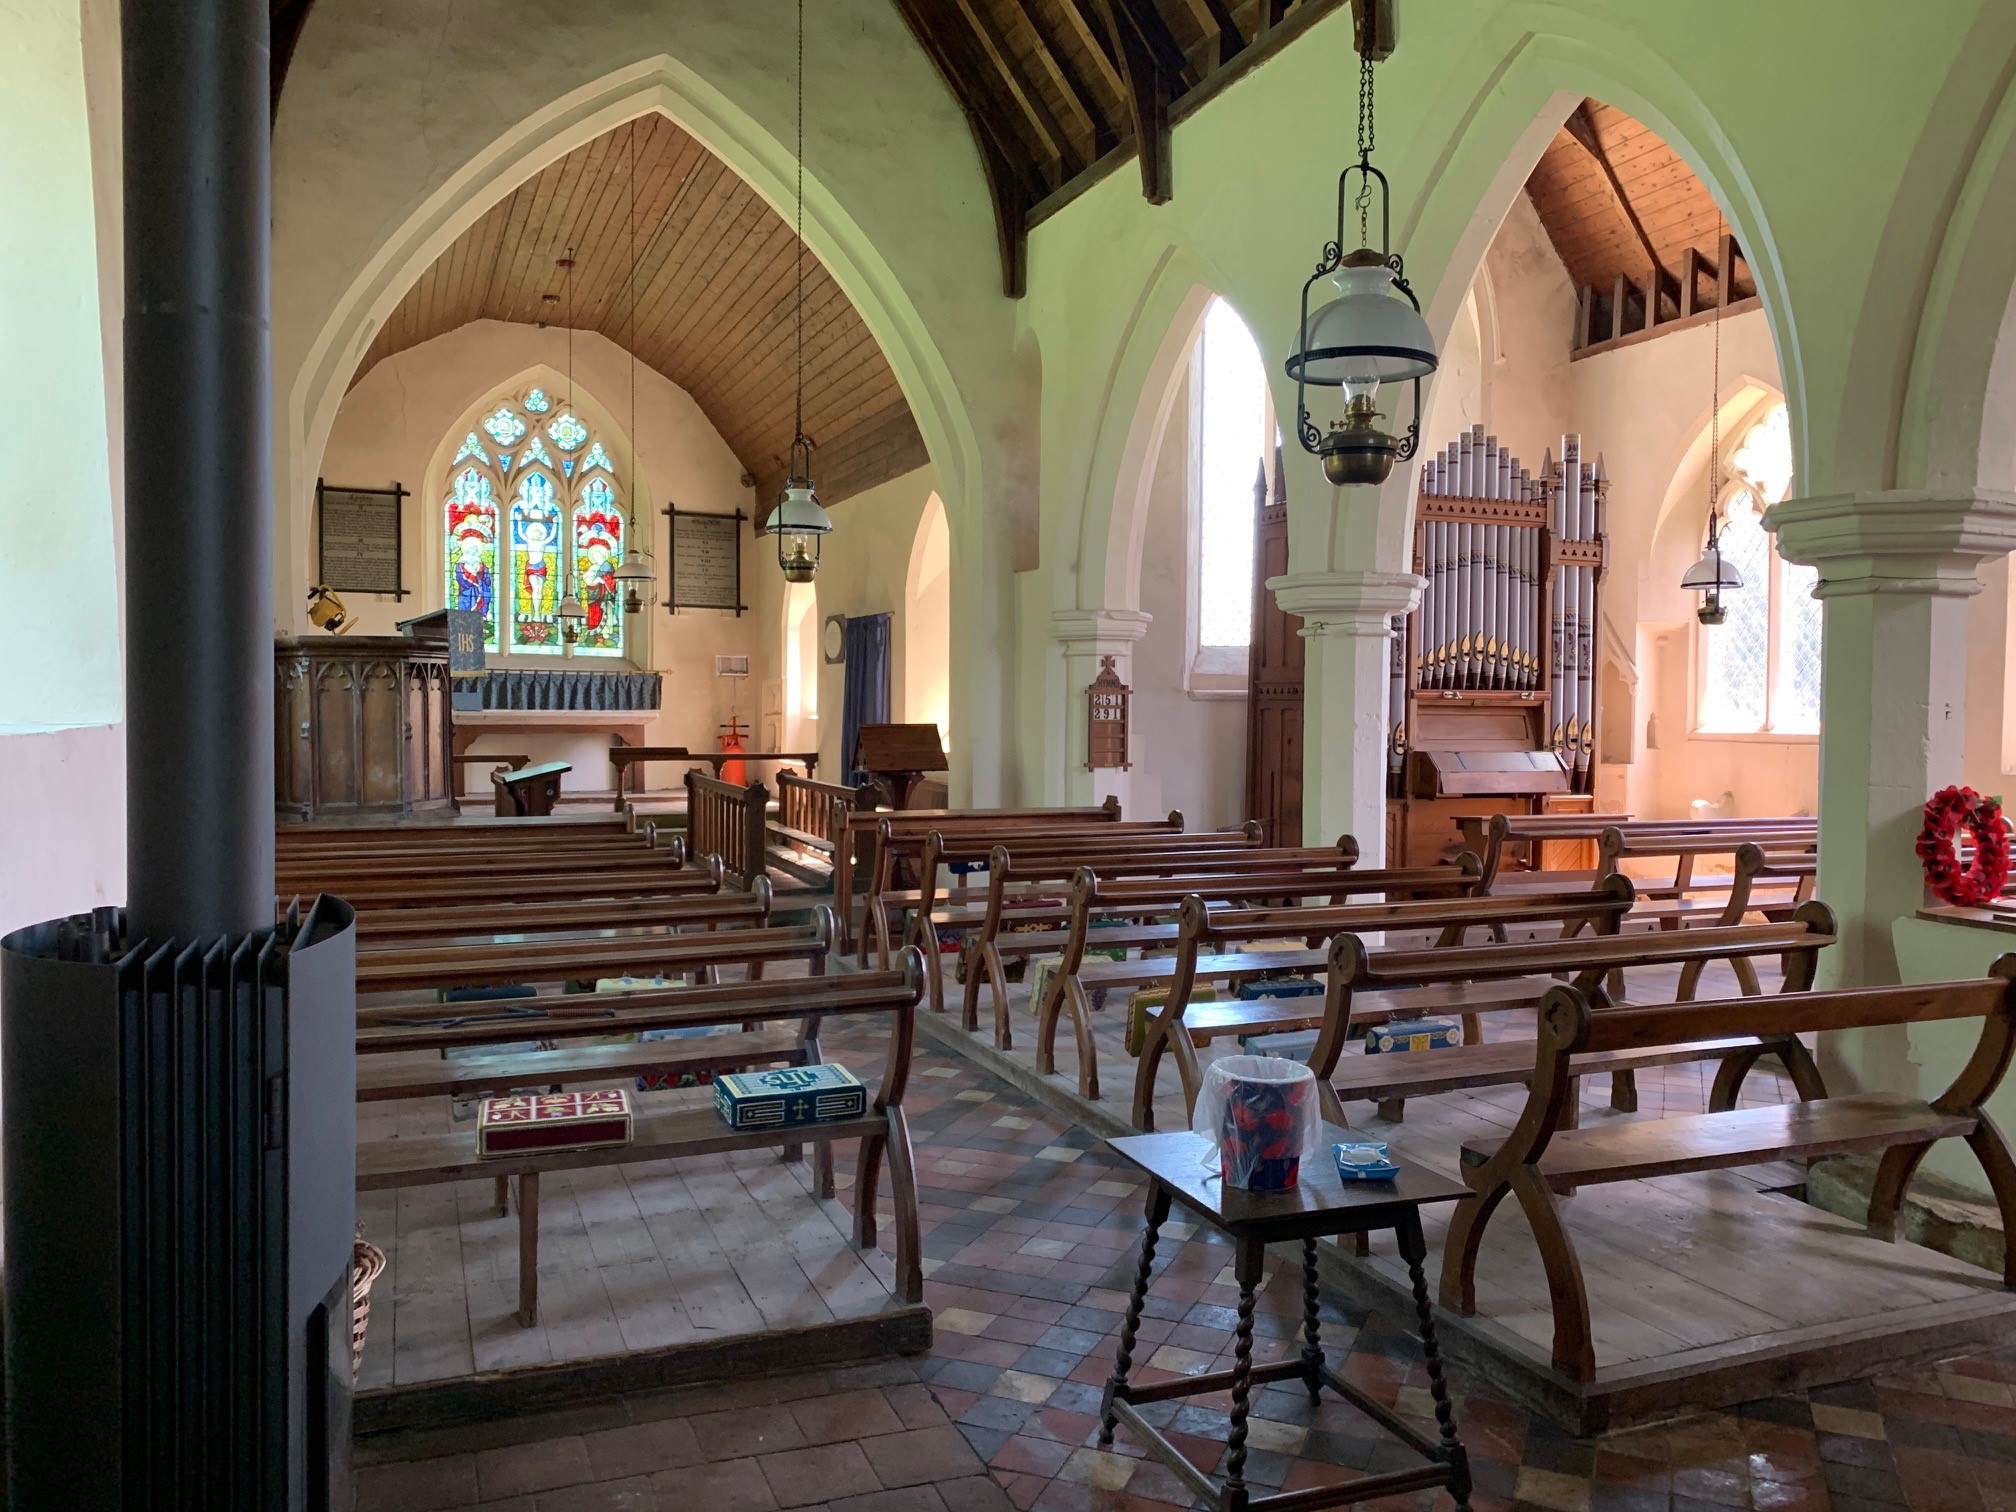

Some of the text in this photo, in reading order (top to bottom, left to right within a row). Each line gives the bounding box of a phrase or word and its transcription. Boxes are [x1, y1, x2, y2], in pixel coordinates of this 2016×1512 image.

[458, 632, 475, 653] IHS
[1097, 679, 1120, 688] HYMNS
[1095, 694, 1118, 705] 251
[1094, 708, 1117, 719] 291
